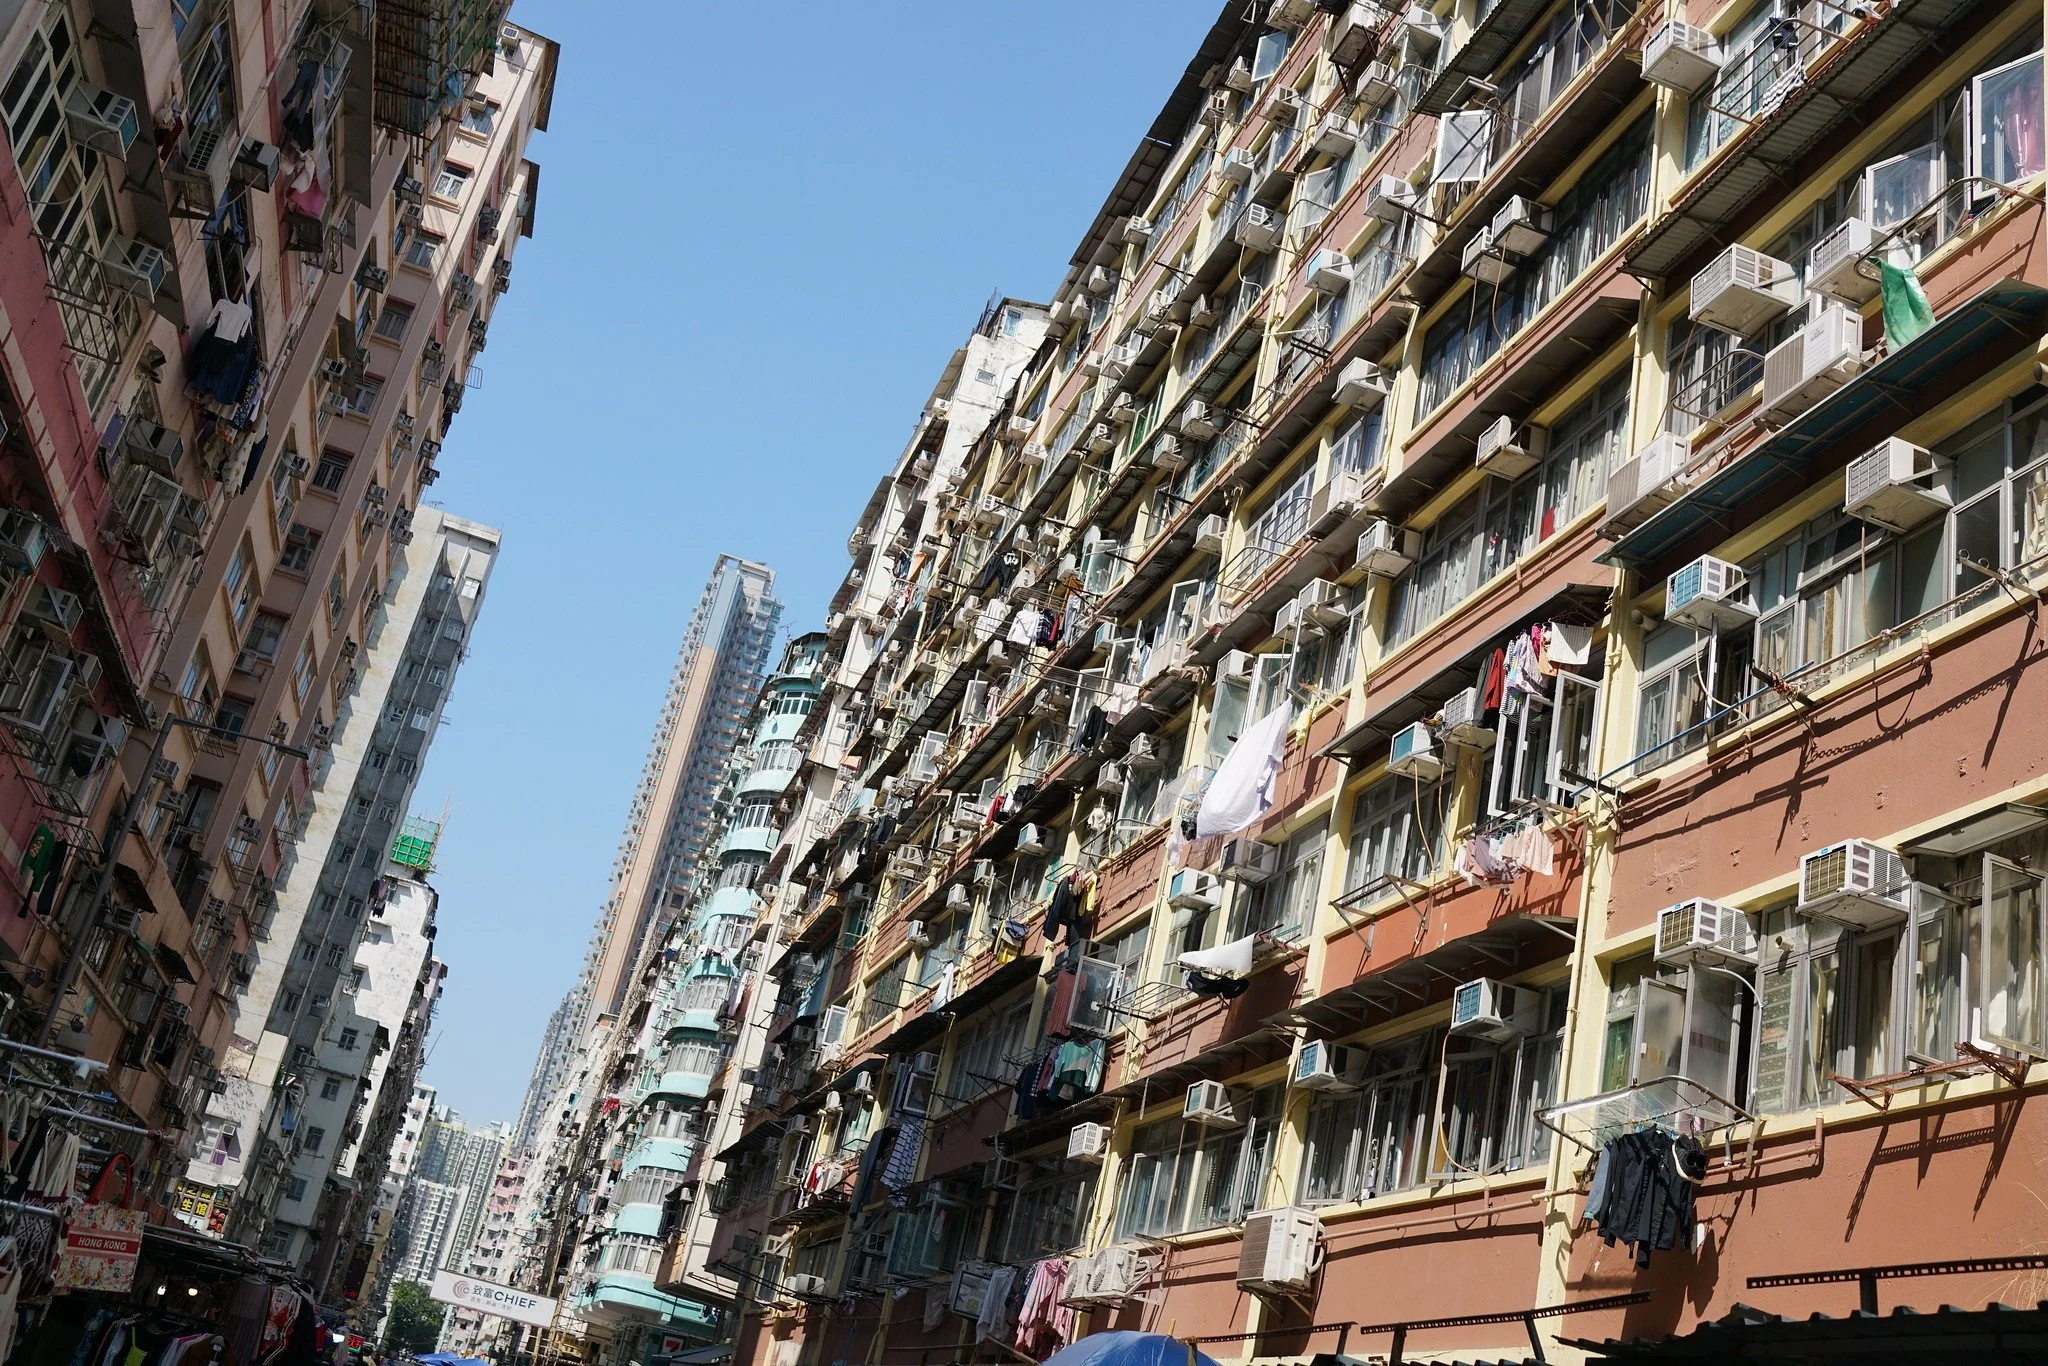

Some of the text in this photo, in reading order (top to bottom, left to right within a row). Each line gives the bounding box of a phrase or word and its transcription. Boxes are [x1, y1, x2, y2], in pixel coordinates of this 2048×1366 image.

[78, 1237, 127, 1251] HONG KONG
[472, 1285, 495, 1299] 致富
[494, 1291, 537, 1309] CHIEF
